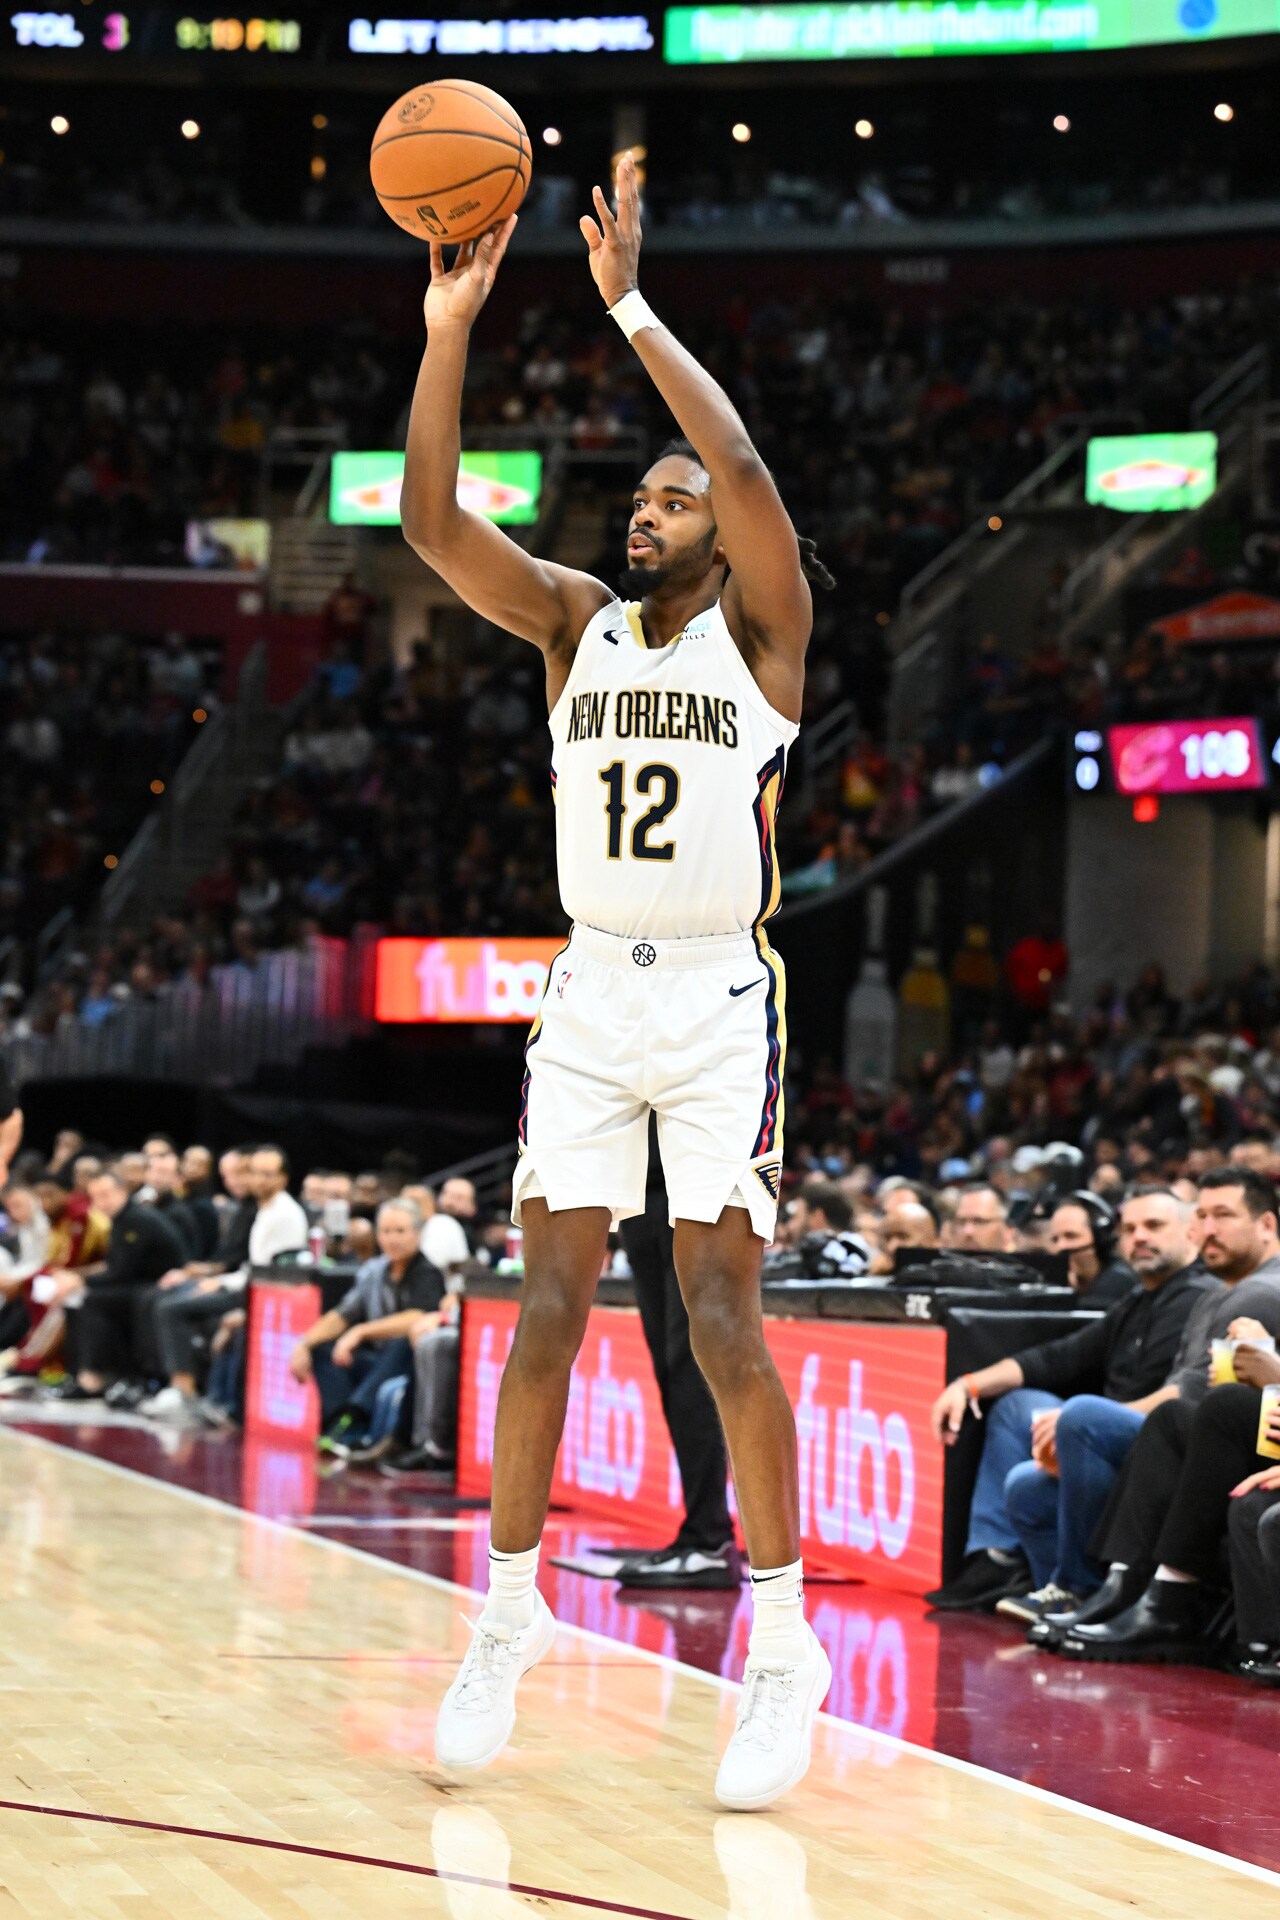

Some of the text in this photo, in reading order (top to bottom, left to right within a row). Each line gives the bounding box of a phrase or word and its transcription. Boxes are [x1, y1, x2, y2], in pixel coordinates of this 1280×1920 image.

[11, 12, 129, 51] TOL 3
[566, 690, 738, 749] NEW ORLEANS
[598, 760, 681, 863] 12
[416, 942, 547, 1019] fubo
[797, 1352, 914, 1559] fubo
